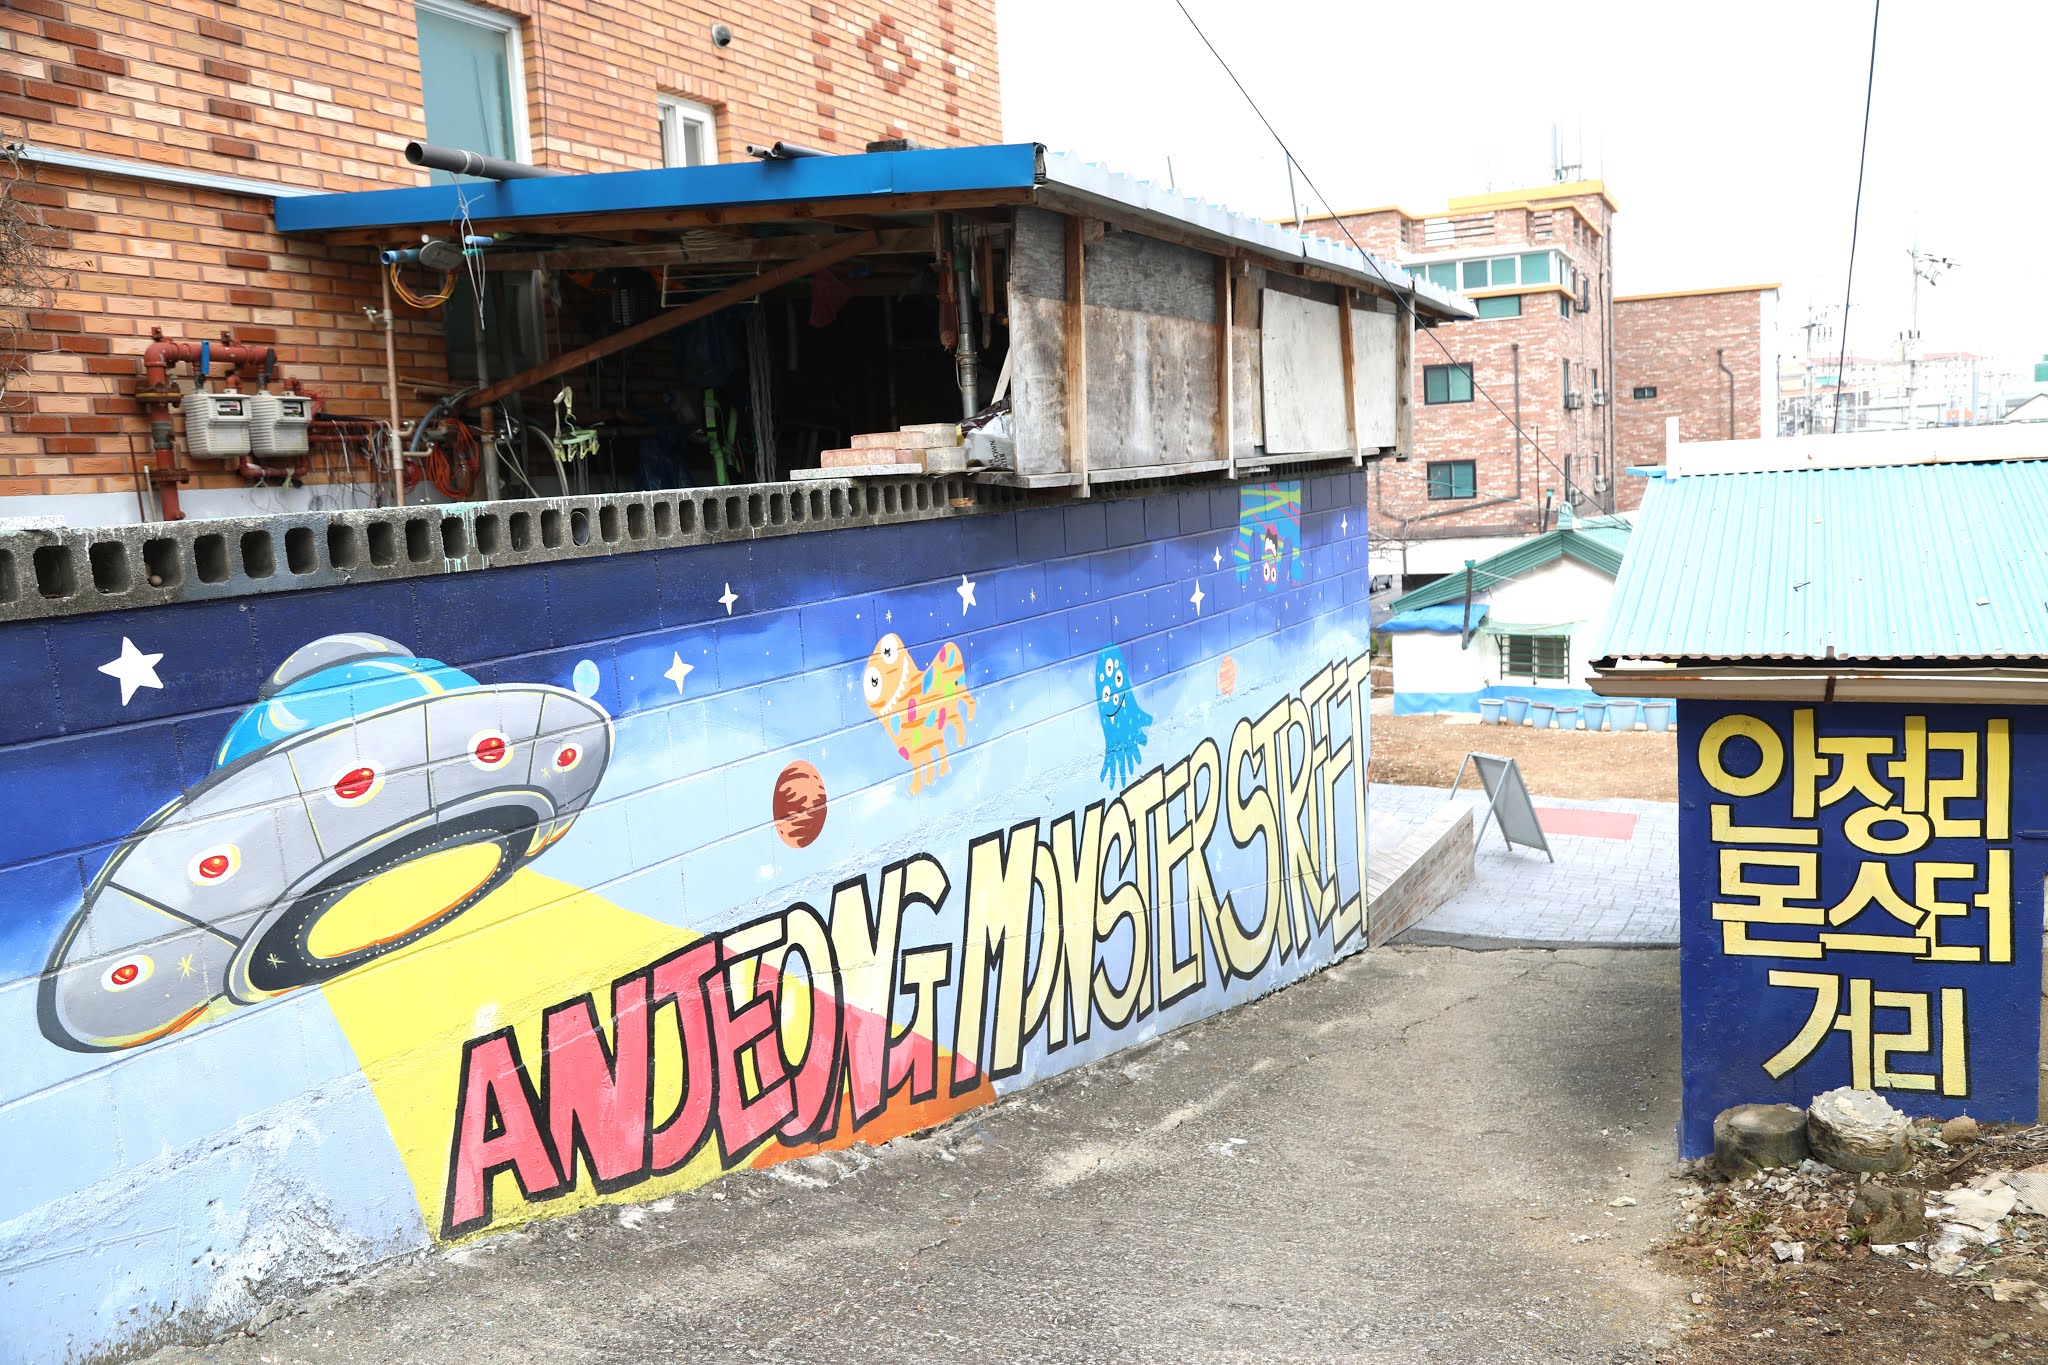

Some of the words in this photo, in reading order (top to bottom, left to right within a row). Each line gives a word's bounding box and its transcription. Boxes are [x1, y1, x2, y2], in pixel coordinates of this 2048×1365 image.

[989, 440, 1001, 463] DOWN
[1698, 708, 2014, 855] 안정리
[440, 852, 951, 1241] ANJEONG
[948, 736, 1231, 1099] MONSTER
[1217, 650, 1371, 982] STREET
[1711, 848, 2015, 964] 몬스터
[1761, 969, 1971, 1099] 거리
